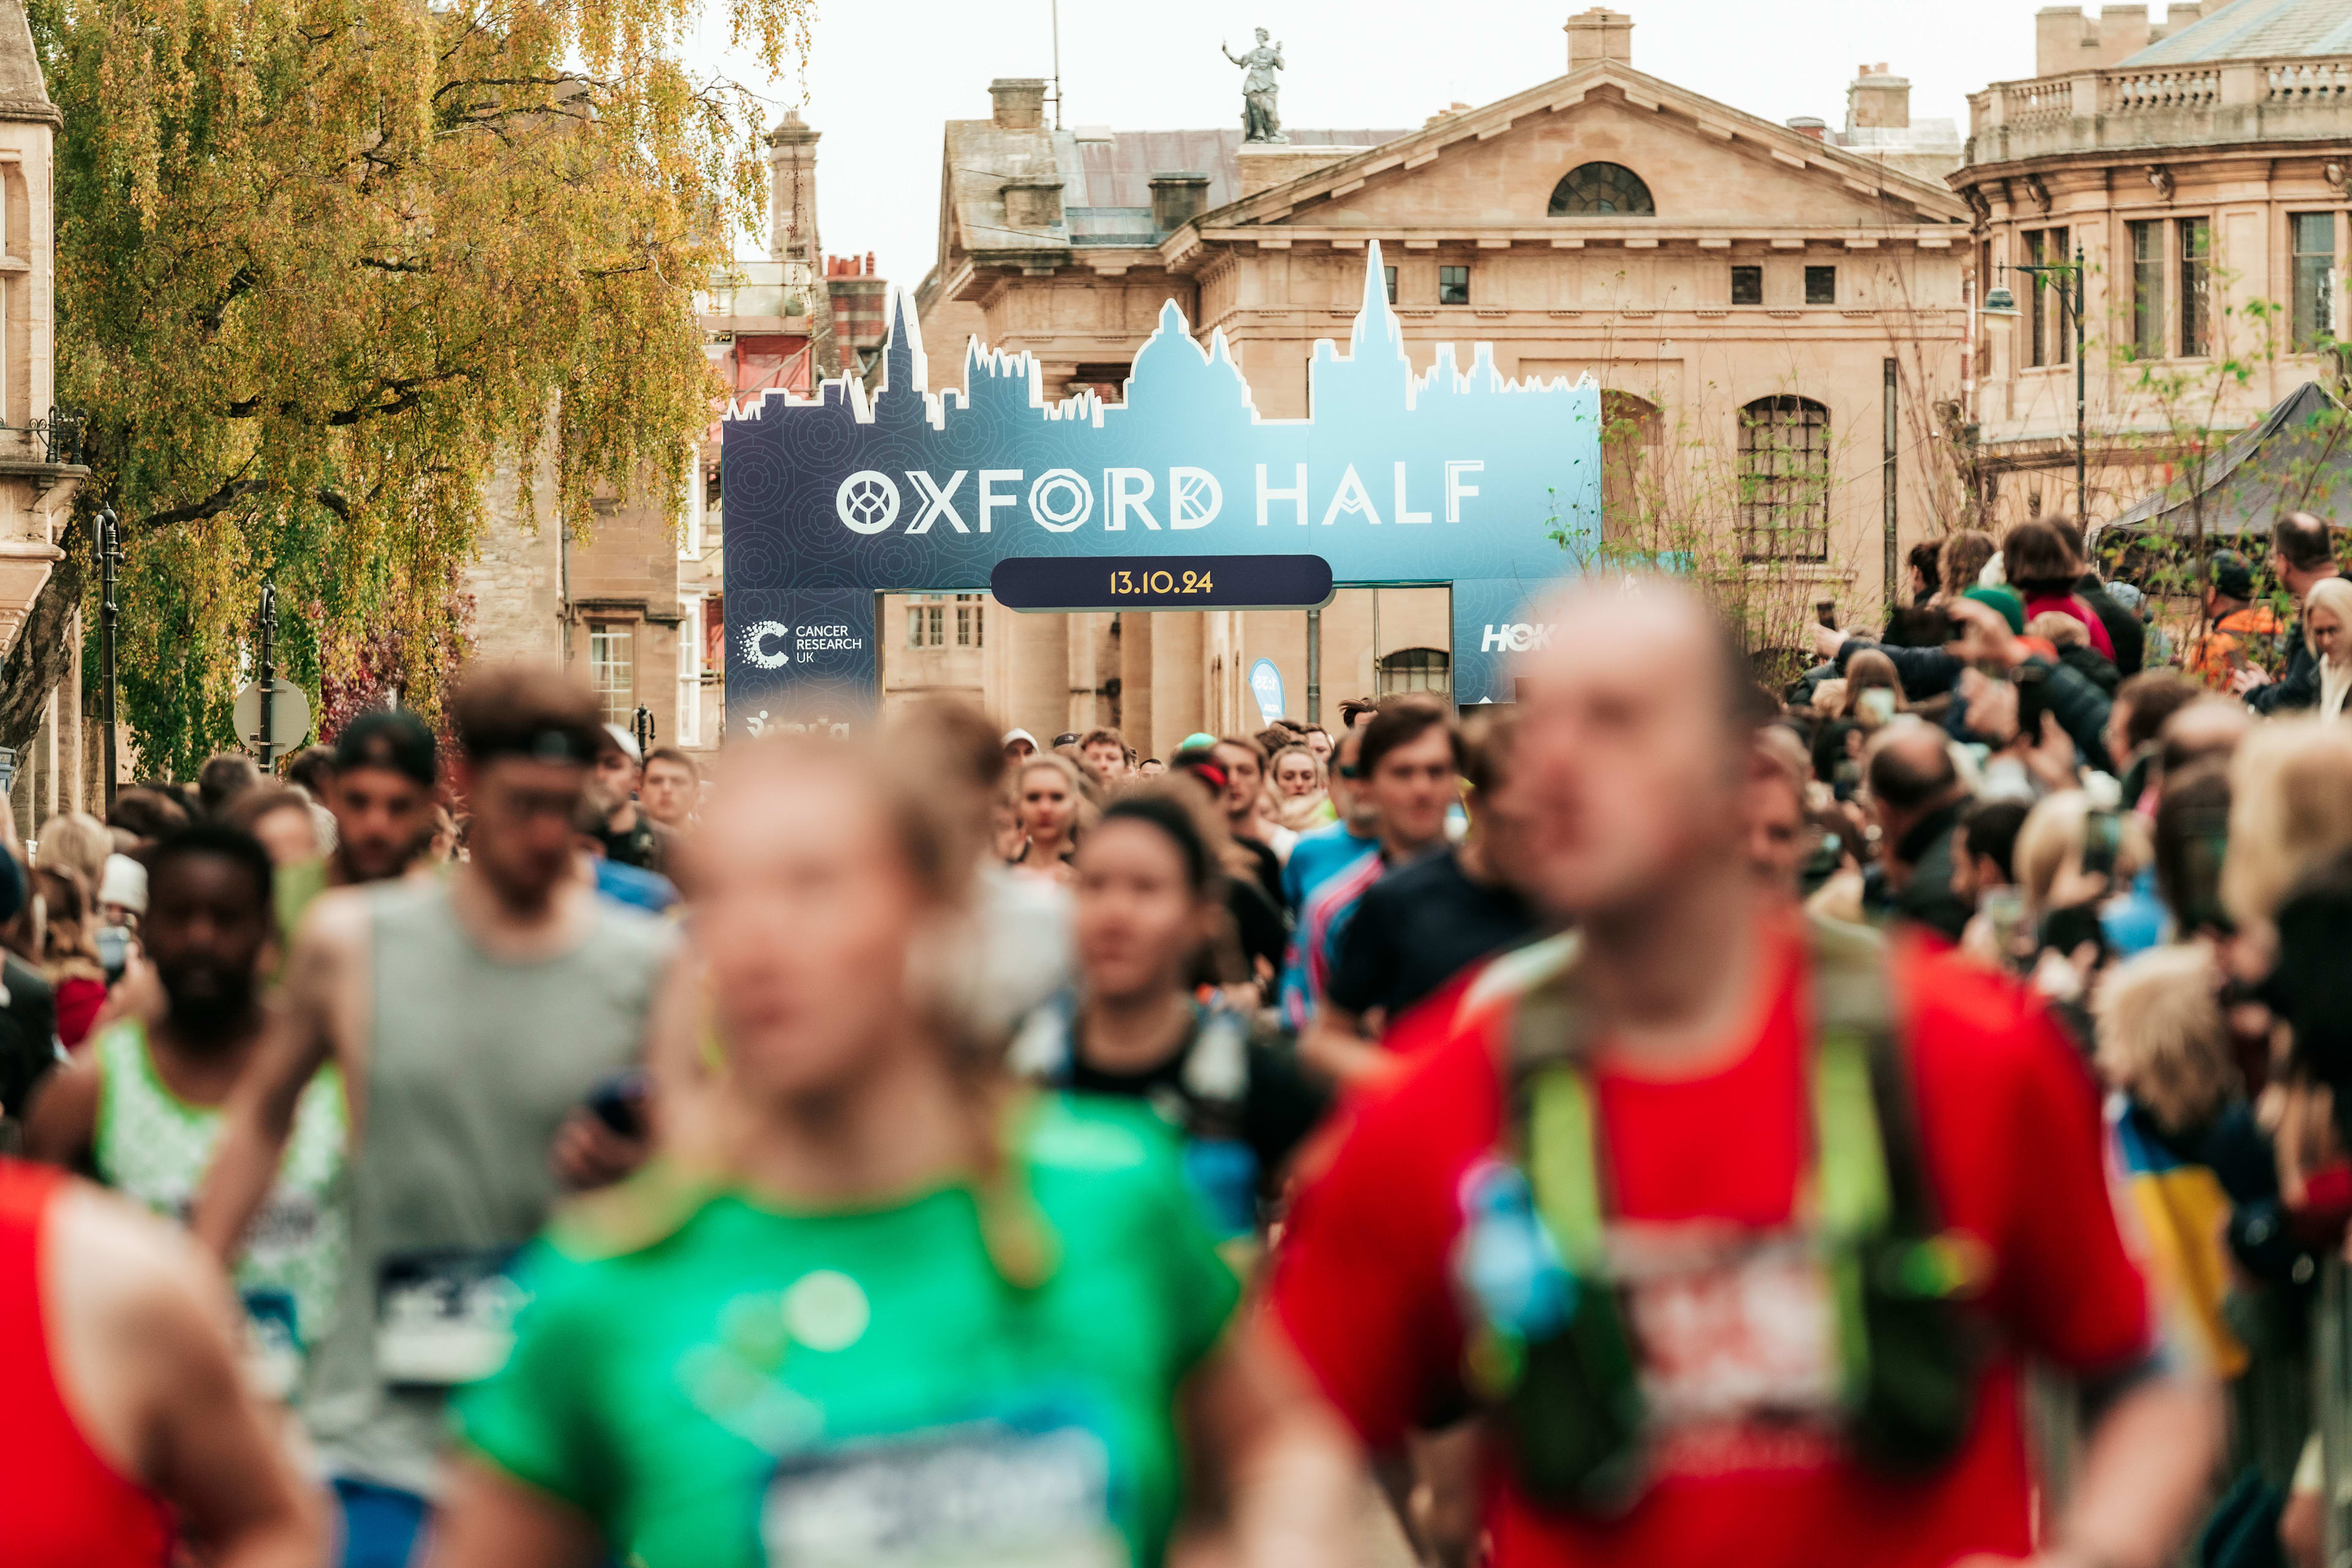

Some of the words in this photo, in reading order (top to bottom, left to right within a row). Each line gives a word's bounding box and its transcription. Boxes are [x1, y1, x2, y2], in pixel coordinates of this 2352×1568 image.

[836, 466, 1223, 534] OXFORD
[1256, 460, 1485, 526] HALF
[1110, 570, 1213, 594] 13.10.24
[796, 625, 848, 637] CANCER
[1481, 623, 1559, 652] HOK
[796, 638, 862, 650] RESEARCH
[797, 652, 814, 663] UK
